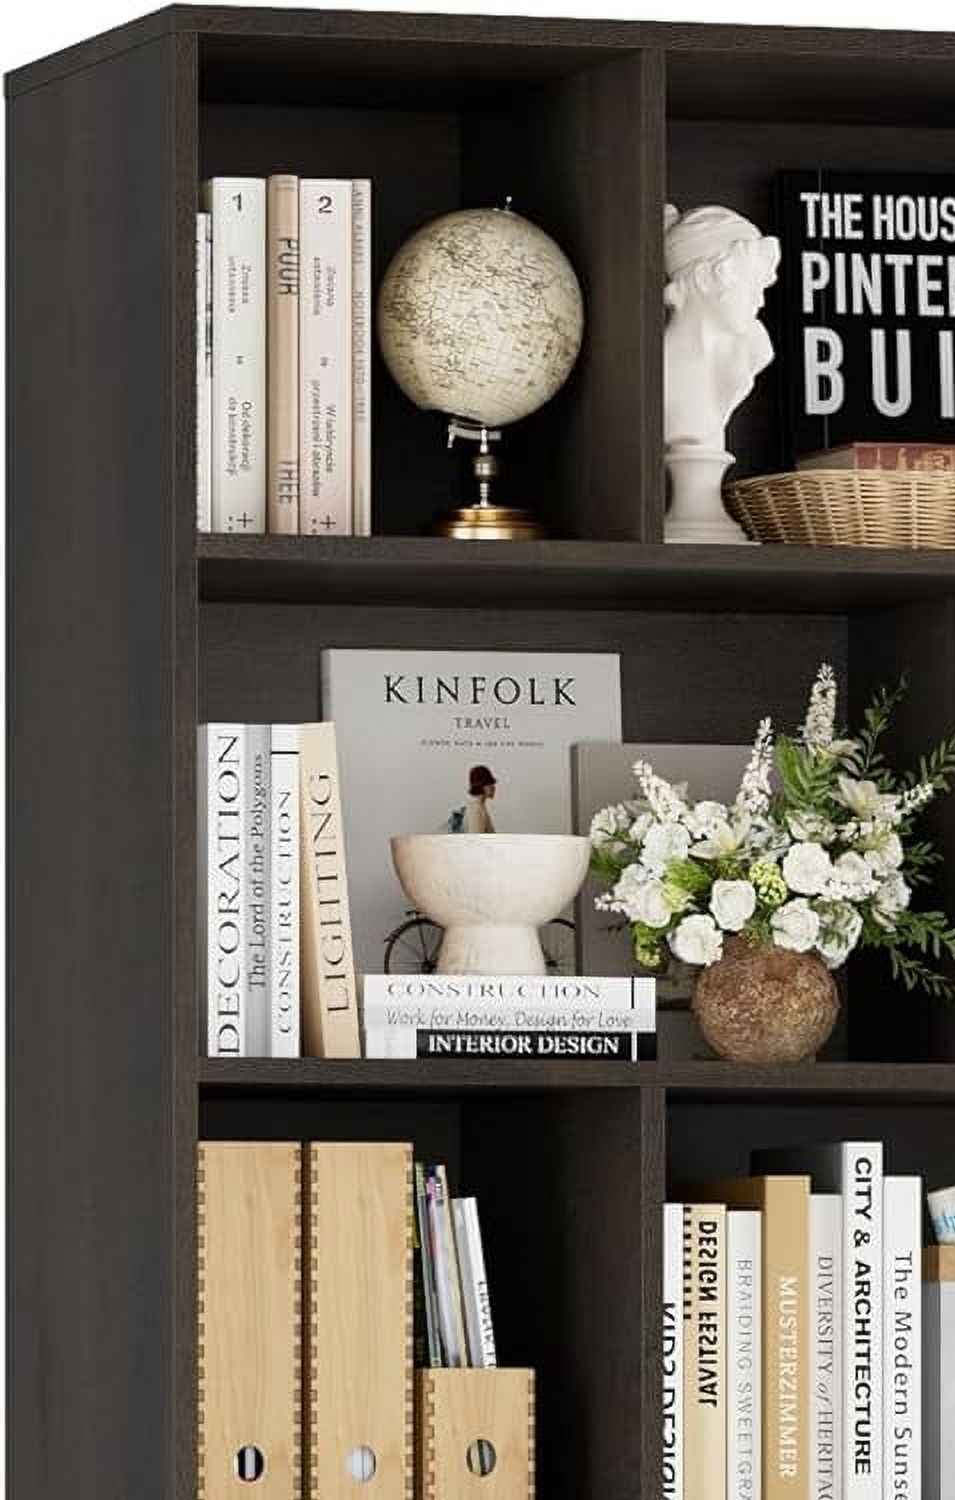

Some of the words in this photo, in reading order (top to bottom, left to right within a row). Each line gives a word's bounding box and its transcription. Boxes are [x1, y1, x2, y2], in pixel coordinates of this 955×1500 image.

[232, 193, 244, 213] 1
[317, 196, 333, 214] 2
[800, 192, 863, 240] THE
[384, 674, 577, 706] KINFOLK
[454, 717, 512, 729] TRAVEL
[249, 754, 270, 839] Polygons
[248, 843, 266, 876] the
[217, 735, 240, 1055] DECORATION
[248, 878, 266, 900] of
[278, 791, 292, 1034] CONSTRUCTION
[310, 774, 350, 1013] LIGHTING
[248, 903, 266, 950] Lord
[248, 952, 266, 992] The
[387, 982, 601, 999] CONSTRUCTION
[387, 1008, 426, 1025] Work
[429, 1008, 451, 1028] for
[571, 1011, 595, 1028] for
[428, 1034, 533, 1054] INTERIOR
[537, 1035, 620, 1055] DESIGN
[854, 1157, 872, 1220] CITY
[853, 1229, 871, 1248] &
[893, 1251, 912, 1300] The
[736, 1259, 753, 1370] BRAIDING
[817, 1255, 834, 1374] DIVERSITY
[778, 1275, 797, 1478] MUSTERZIMMER
[854, 1260, 872, 1474] ARCHITECTURE
[893, 1311, 912, 1415] Modern
[815, 1382, 833, 1403] of
